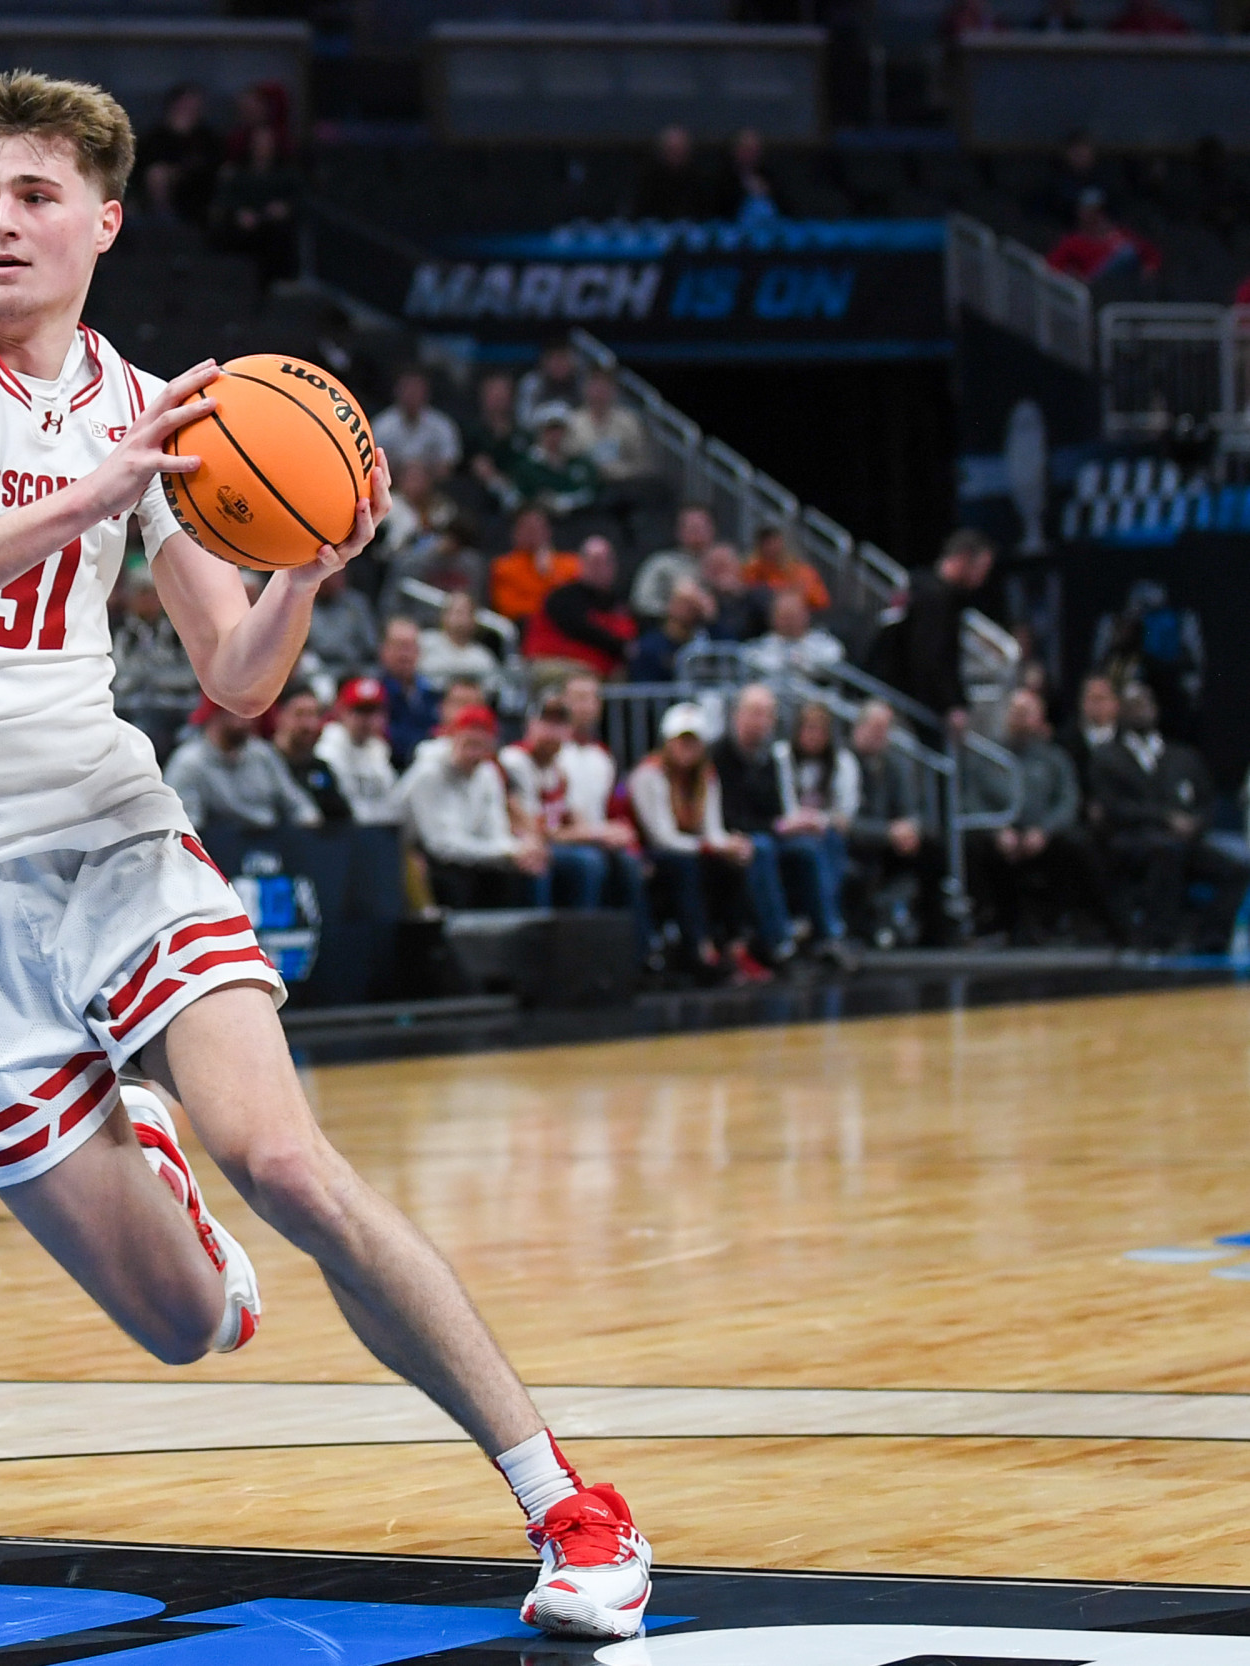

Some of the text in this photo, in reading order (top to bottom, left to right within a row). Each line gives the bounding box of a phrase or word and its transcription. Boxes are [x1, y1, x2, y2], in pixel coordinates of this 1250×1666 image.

[405, 264, 854, 319] MARCH IS ON
